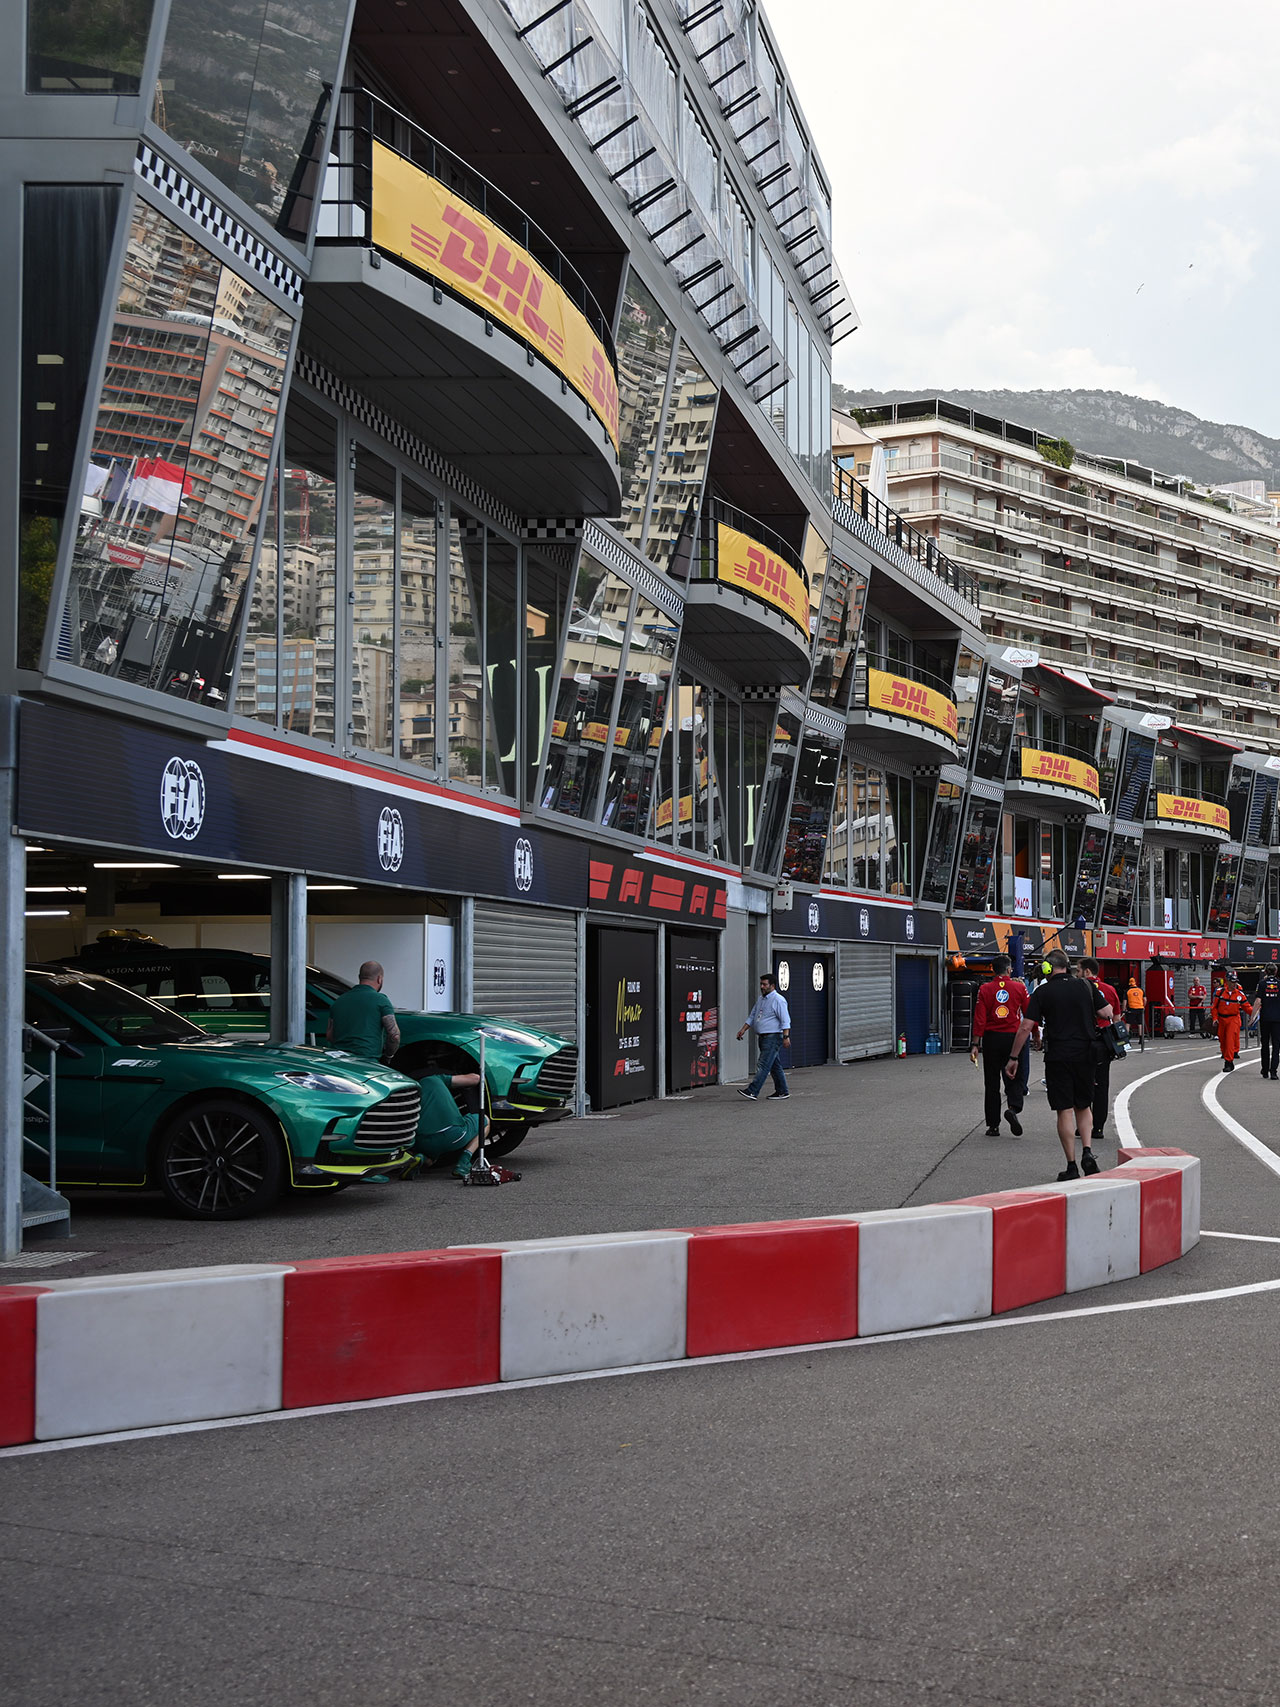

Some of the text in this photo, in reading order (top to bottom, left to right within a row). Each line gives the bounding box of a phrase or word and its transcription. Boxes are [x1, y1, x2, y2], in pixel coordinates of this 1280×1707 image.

[439, 205, 549, 342] DHL
[746, 546, 791, 604] DHL
[891, 680, 930, 718] DHL
[1039, 755, 1072, 781] DHL
[1173, 799, 1201, 819] DHL
[1148, 940, 1154, 955] 44
[104, 965, 172, 975] ASTON MARTIN
[997, 991, 1007, 1003] hp
